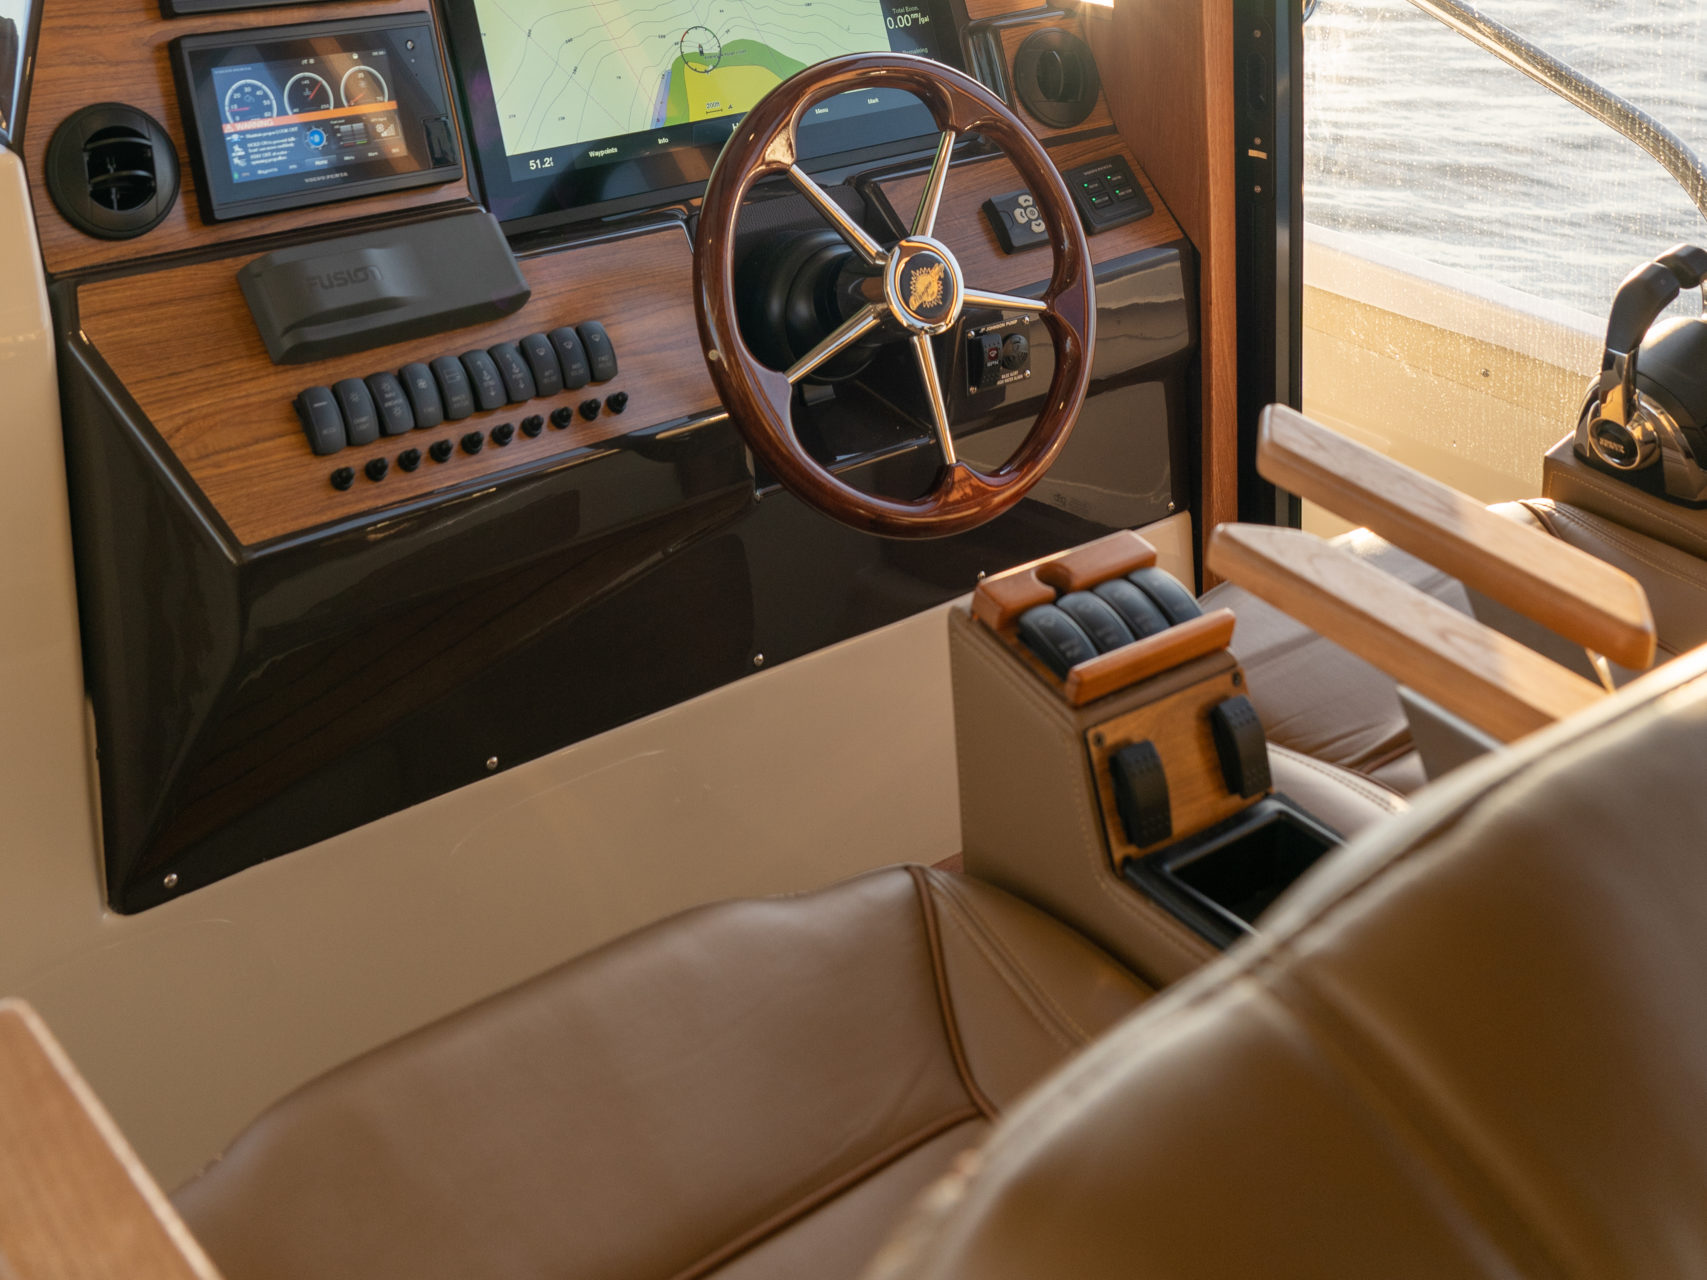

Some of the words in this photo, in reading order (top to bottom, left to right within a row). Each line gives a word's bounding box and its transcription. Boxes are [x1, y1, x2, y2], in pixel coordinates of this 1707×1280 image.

[886, 14, 912, 29] 0.00
[588, 146, 618, 158] Waypoints
[657, 137, 669, 145] Info
[529, 157, 551, 170] 51.2
